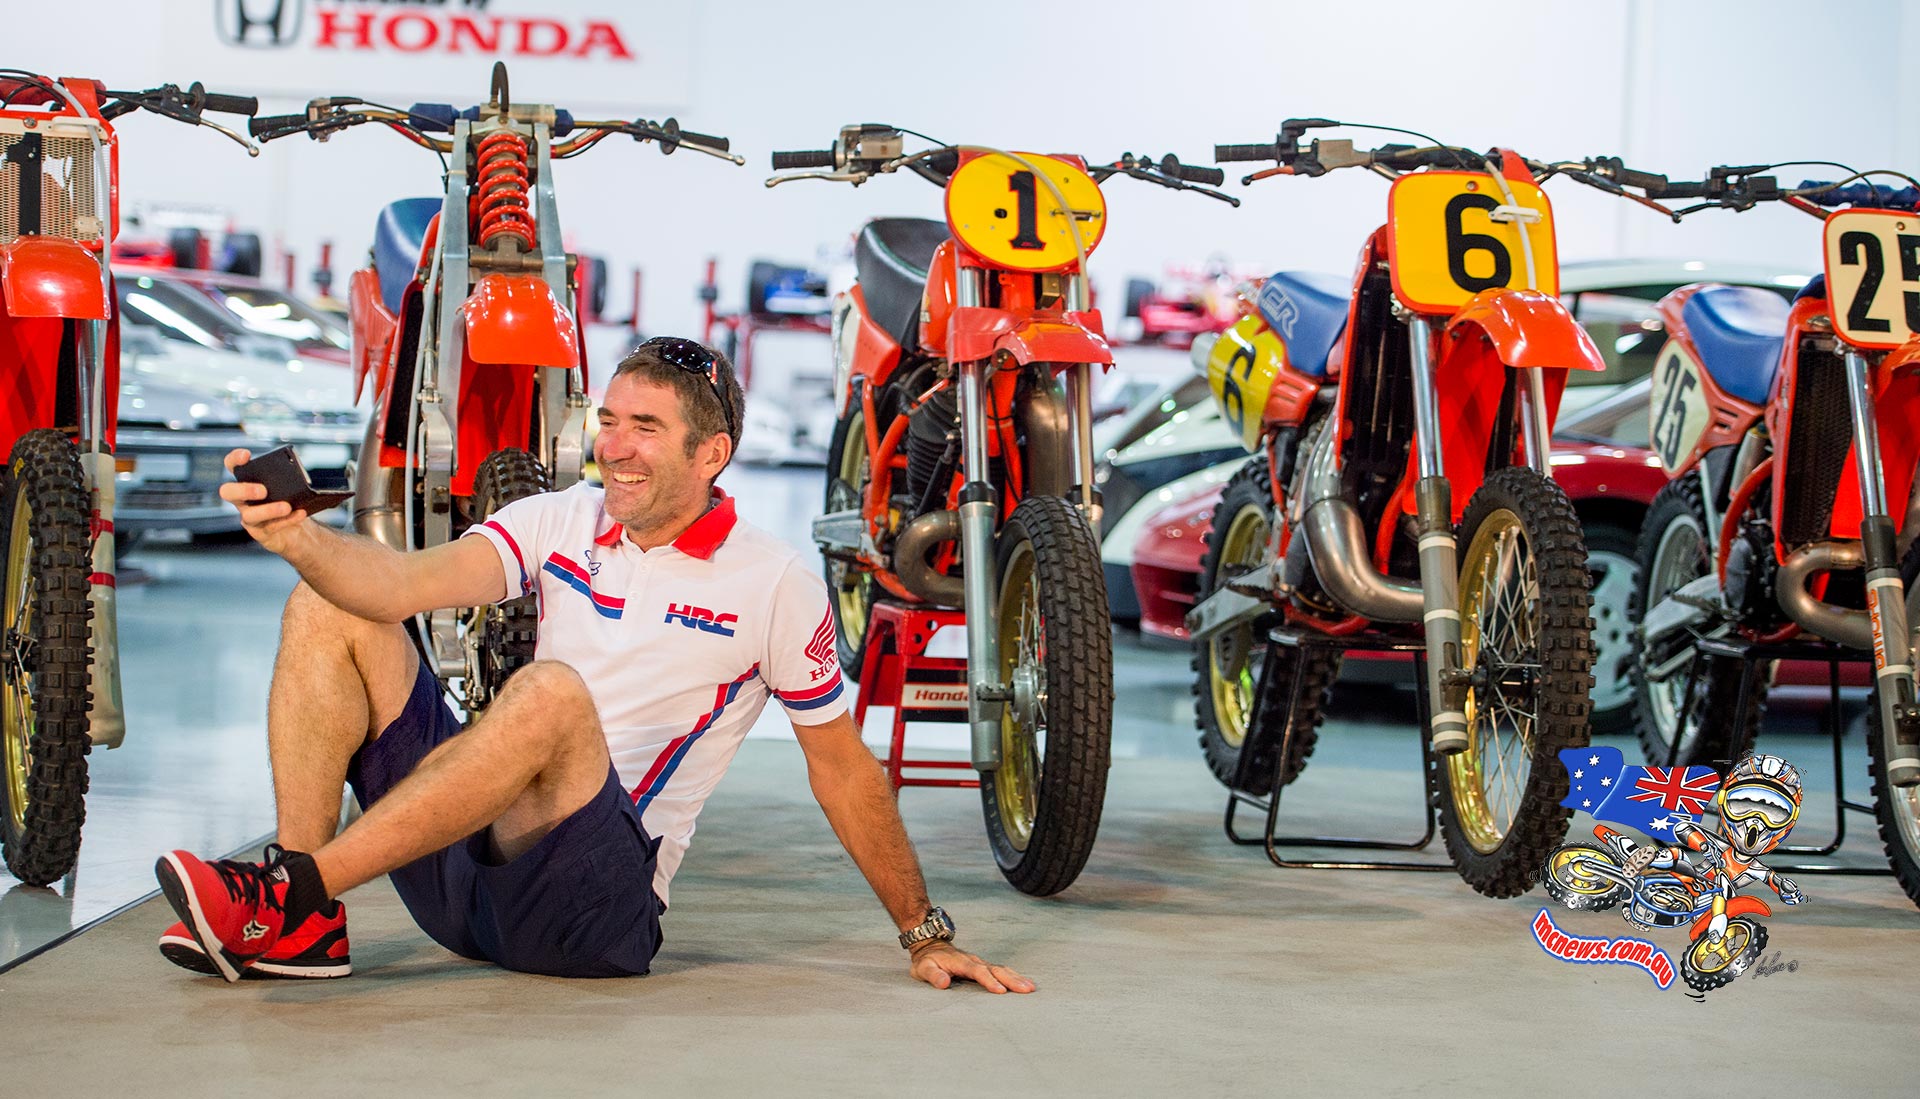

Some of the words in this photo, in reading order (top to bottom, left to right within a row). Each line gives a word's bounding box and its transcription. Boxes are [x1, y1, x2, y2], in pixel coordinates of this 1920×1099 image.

[314, 10, 636, 61] HONDA
[1008, 170, 1046, 251] 1
[1445, 193, 1512, 293] 6
[1223, 343, 1257, 438] 6
[1653, 353, 1697, 469] 25
[664, 602, 739, 638] HRC
